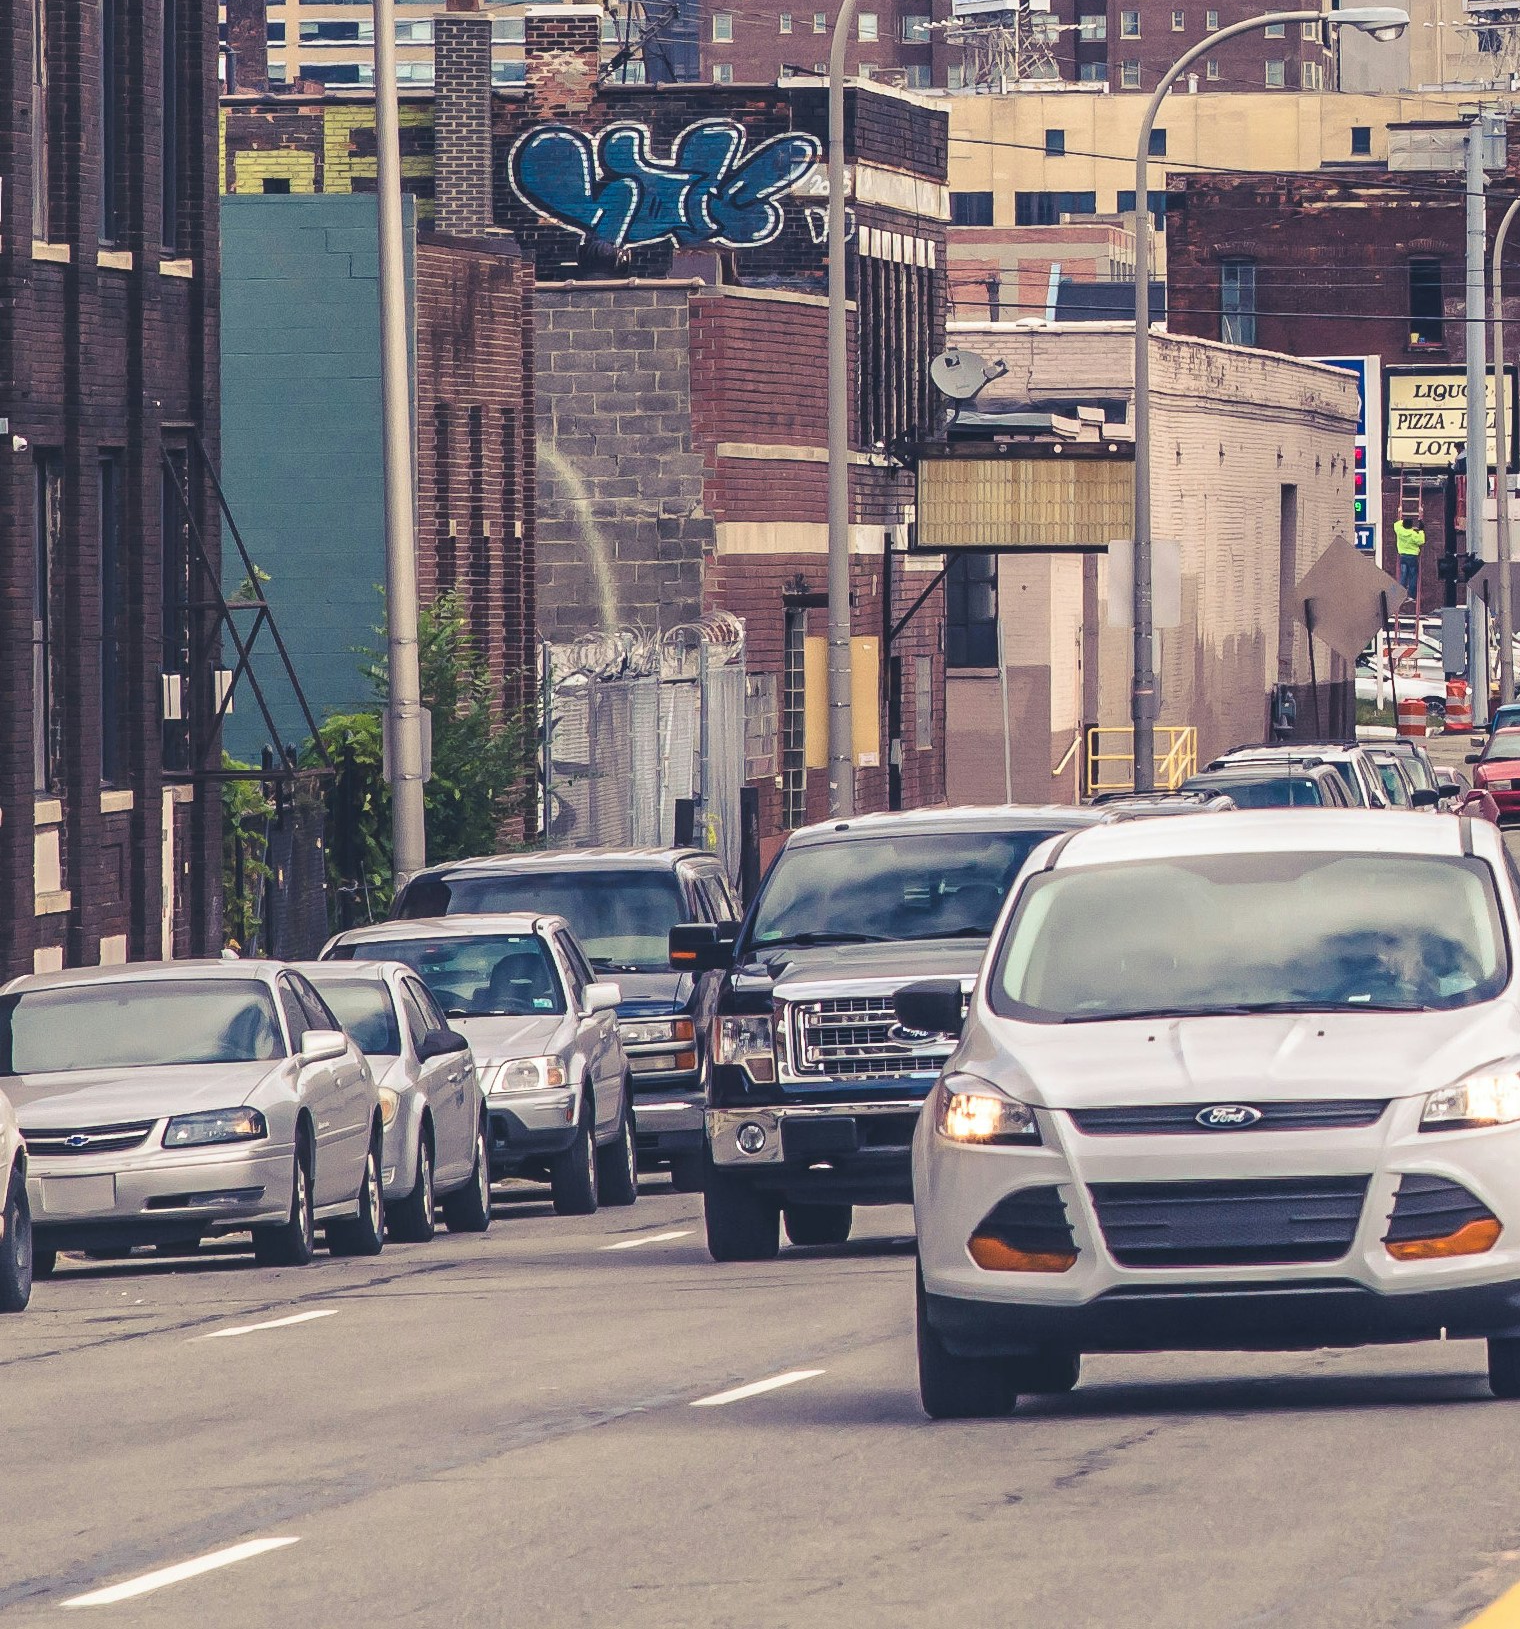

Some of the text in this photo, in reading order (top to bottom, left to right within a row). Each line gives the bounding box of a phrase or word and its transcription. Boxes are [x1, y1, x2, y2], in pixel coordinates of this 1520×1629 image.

[1413, 384, 1488, 401] LIQU
[1397, 413, 1446, 430] PIZZA
[1209, 1107, 1246, 1123] Ford
